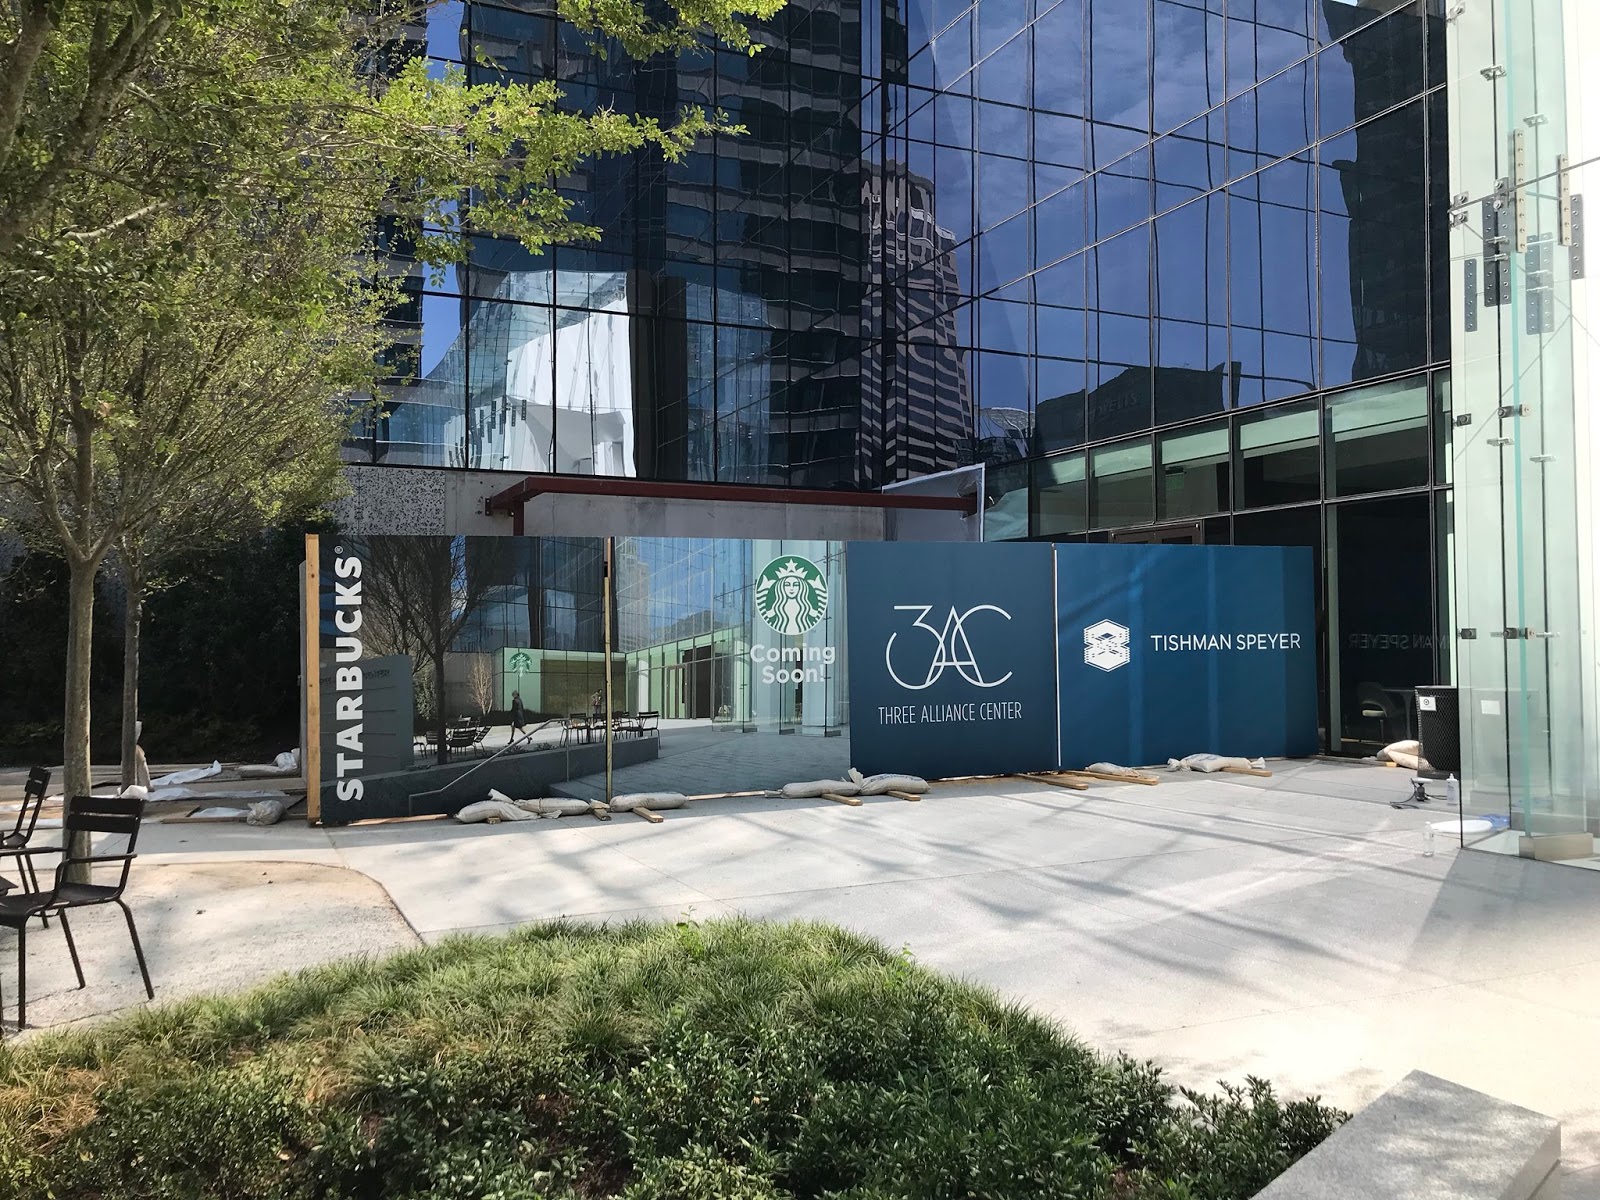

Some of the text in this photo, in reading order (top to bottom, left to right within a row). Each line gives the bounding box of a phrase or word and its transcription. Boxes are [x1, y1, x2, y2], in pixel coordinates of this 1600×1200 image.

[1150, 633, 1301, 652] TISHMAN SPEYER
[750, 643, 836, 665] Coming
[762, 664, 826, 684] Soon!
[878, 701, 1022, 725] THREE ALLIANCE CENTER
